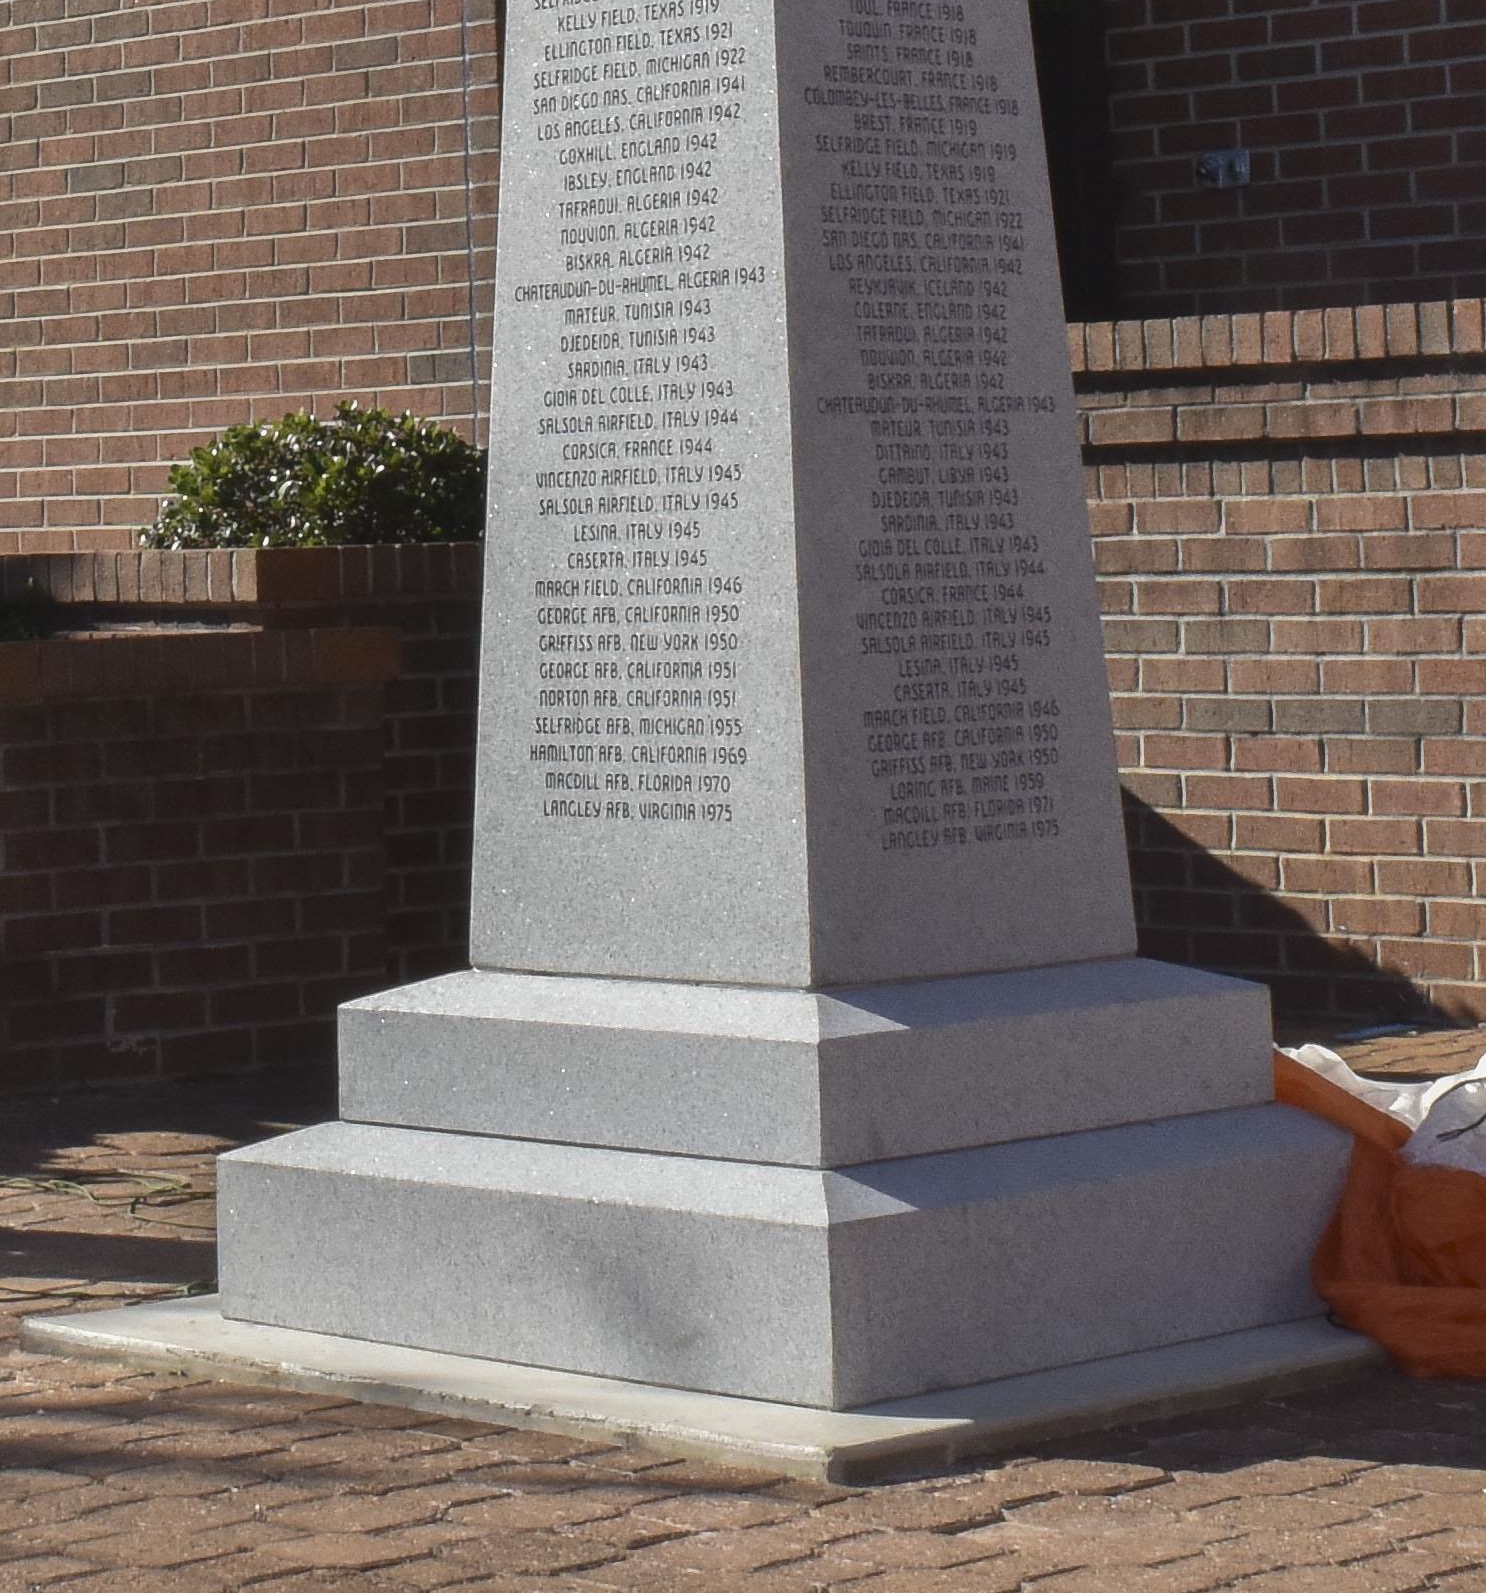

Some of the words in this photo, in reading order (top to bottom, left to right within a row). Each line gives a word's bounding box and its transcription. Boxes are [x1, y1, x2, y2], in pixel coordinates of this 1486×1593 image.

[557, 11, 596, 33] KELLY
[645, 0, 684, 21] TEXAS
[544, 36, 611, 61] ELLINGTON
[660, 24, 699, 46] TEXAS
[705, 20, 732, 41] 1921
[533, 95, 556, 115] SAN
[636, 78, 710, 103] CALIFORNIA
[716, 74, 745, 94] 1941
[537, 122, 560, 141] LOS
[629, 106, 703, 131] CALIFORNIA
[708, 102, 740, 122] 1942
[621, 136, 680, 159] ENGLAND
[686, 132, 717, 152] 1942
[619, 245, 672, 267] ALGERIA
[678, 242, 709, 262] 1942
[625, 300, 673, 321] TUNISIA
[679, 297, 710, 317] 1943
[629, 327, 677, 348] TUNISIA
[683, 325, 714, 344] 1943
[633, 355, 670, 375] ITALY
[676, 353, 707, 372] 1943
[543, 388, 577, 408] GIOIA
[581, 387, 604, 406] DEL
[658, 381, 695, 401] ITALY
[701, 379, 733, 399] 1943
[538, 414, 592, 435] SALSOLA
[662, 409, 699, 428] ITALY
[704, 407, 738, 426] 1944
[624, 438, 672, 458] FRANCE
[679, 437, 712, 455] 1944
[535, 468, 596, 489] VINCENZO
[665, 464, 703, 484] ITALY
[708, 463, 741, 482] 1945
[625, 521, 662, 540] ITALY
[668, 520, 700, 539] 1945
[632, 549, 669, 568] ITALY
[675, 548, 707, 567] 1945
[534, 579, 579, 597] MARCH
[627, 575, 702, 596] CALIFORNIA
[708, 575, 742, 594] 1946
[537, 606, 586, 625] GEORGE
[625, 603, 700, 624] CALIFORNIA
[706, 604, 739, 623] 1950
[538, 633, 592, 652] GRIFFISS
[630, 632, 658, 652] NEW
[663, 632, 698, 651] YORK
[704, 632, 738, 651] 1950
[535, 715, 600, 735] SELFRIDGE
[639, 717, 704, 735] MICHIGAN
[708, 717, 741, 736] 1955
[529, 743, 593, 762] HAMILTON
[631, 745, 706, 763] CALIFORNIA
[712, 746, 747, 765] 1969
[545, 771, 598, 790] MACDILL
[638, 773, 691, 792] FLORIDA
[698, 774, 730, 793] 1970
[543, 799, 601, 818] LANGLEY
[638, 802, 695, 820] VIRGINIA
[701, 803, 732, 822] 1975
